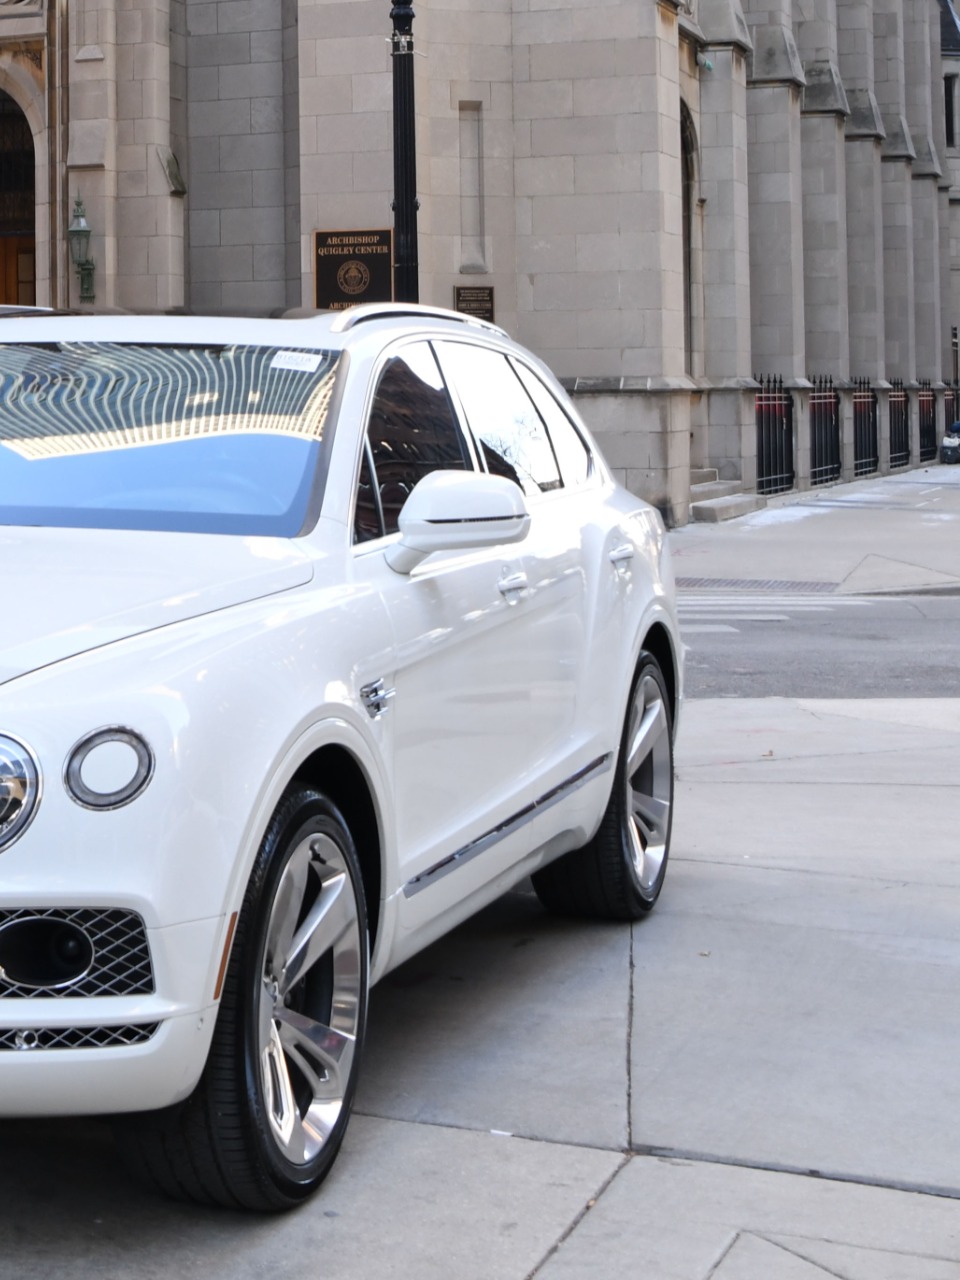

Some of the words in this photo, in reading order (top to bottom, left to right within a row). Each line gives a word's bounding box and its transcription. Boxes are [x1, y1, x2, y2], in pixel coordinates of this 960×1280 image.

[326, 235, 380, 245] ARCHBISHOP
[318, 246, 354, 256] QUIGLEY
[355, 245, 389, 254] CENTER
